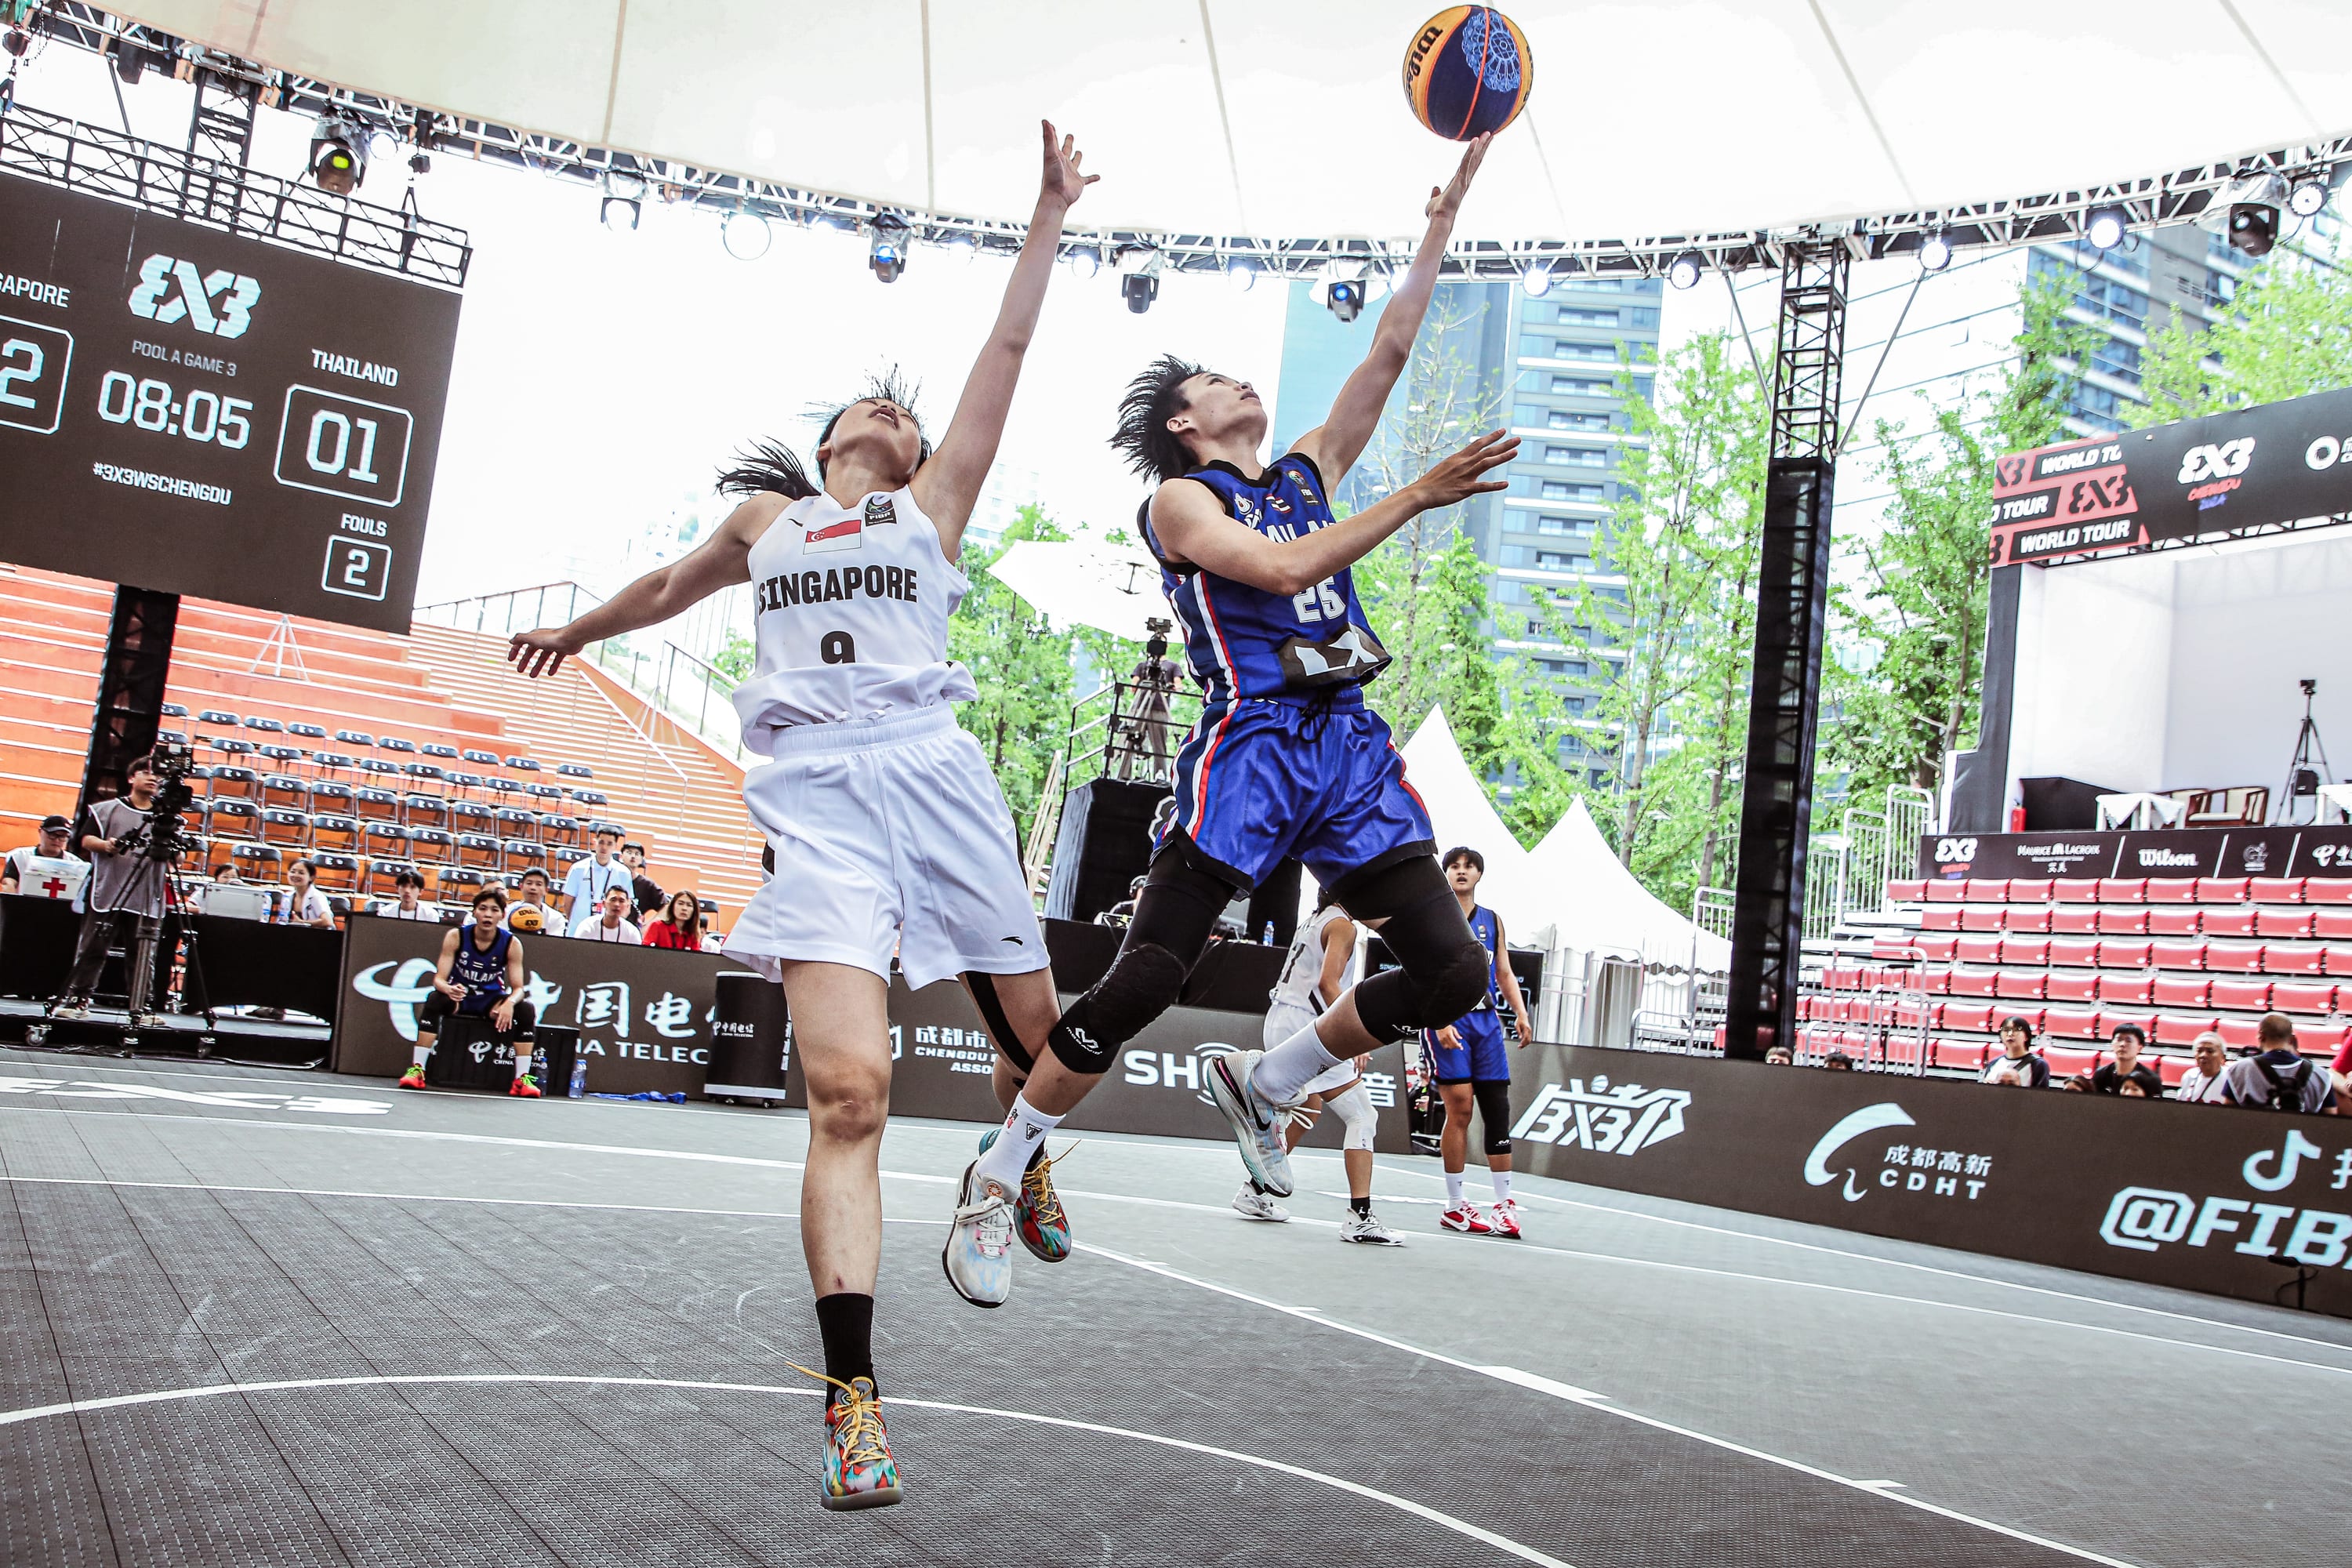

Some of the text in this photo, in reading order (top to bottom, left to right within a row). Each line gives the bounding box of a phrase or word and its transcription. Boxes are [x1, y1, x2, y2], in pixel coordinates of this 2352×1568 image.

[0, 272, 71, 308] APORE
[132, 339, 238, 377] POOL A GAME 3
[311, 349, 398, 387] THAILAND
[97, 371, 253, 449] 08:05
[306, 408, 379, 484] 01
[2040, 448, 2100, 475] WORLD
[93, 462, 232, 506] #3X3WSCHENGDU
[341, 513, 387, 537] FOULS
[2002, 495, 2049, 520] TOUR
[2020, 528, 2080, 554] WORLD
[2082, 519, 2131, 544] TOUR
[344, 548, 370, 586] 2
[758, 564, 918, 615] SINGAPORE
[1293, 575, 1346, 623] 25
[2139, 848, 2196, 866] Wilson
[523, 970, 716, 1038] 中国电
[615, 1041, 710, 1065] TELEC
[915, 1025, 995, 1051] 成都市
[915, 1046, 987, 1062] CHENGDU
[950, 1062, 994, 1075] ASSO
[1884, 1143, 1992, 1178] 成都高新
[1879, 1168, 1987, 1201] CDHT
[2100, 1185, 2352, 1270] @FIB
